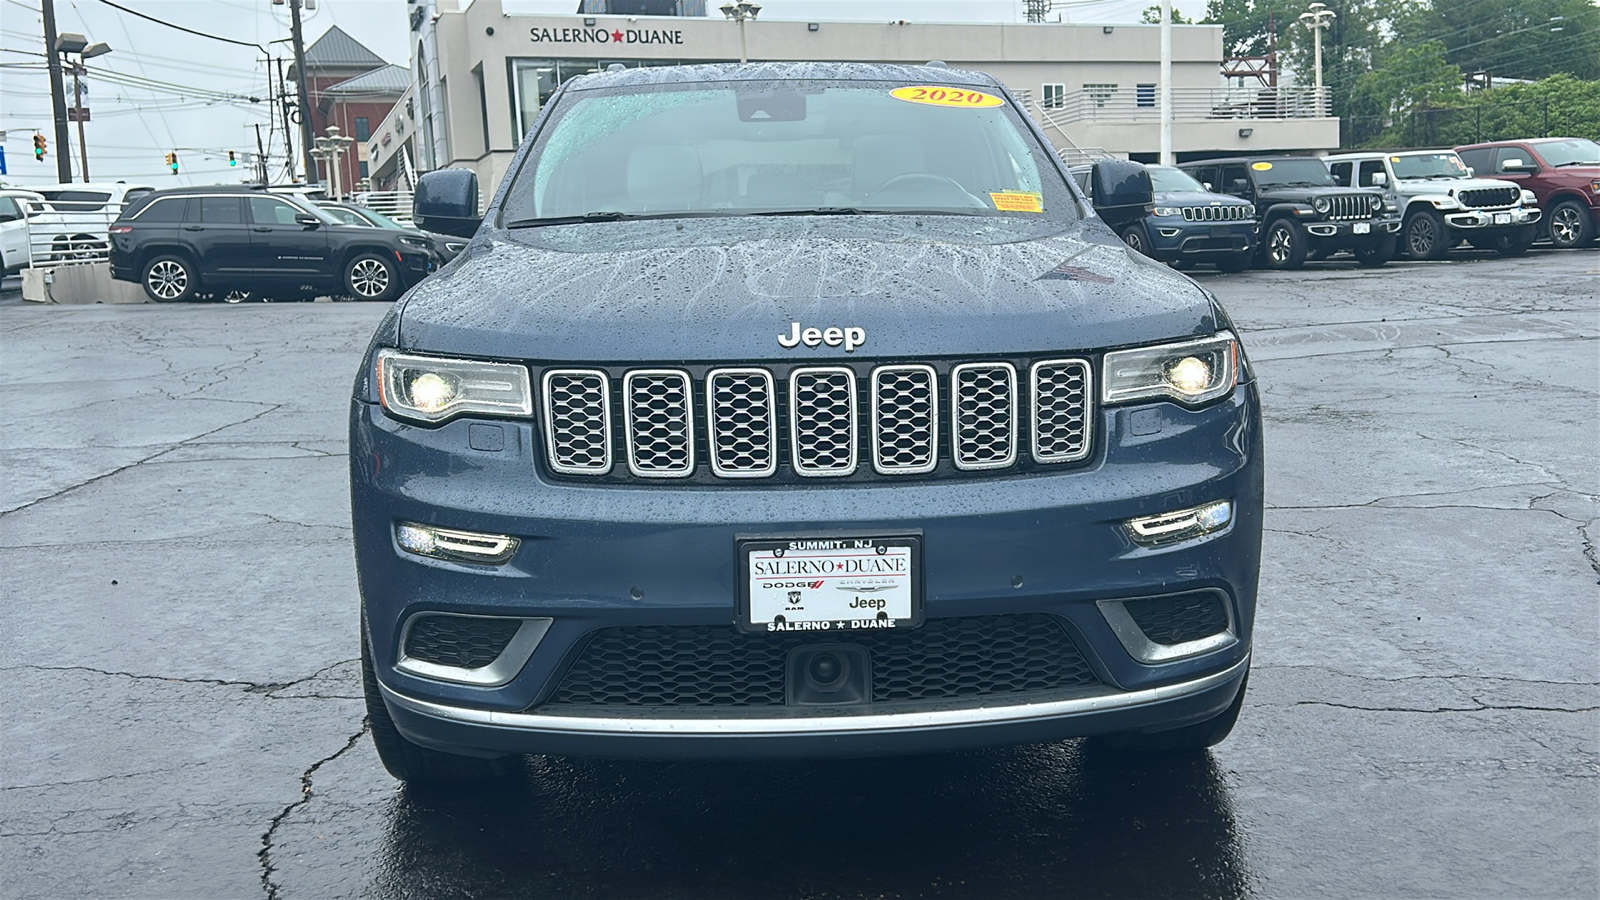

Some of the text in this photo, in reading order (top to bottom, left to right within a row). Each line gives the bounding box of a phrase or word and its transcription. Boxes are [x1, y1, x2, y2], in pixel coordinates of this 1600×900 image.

[530, 28, 684, 44] SALERNO DUANE
[910, 88, 984, 104] 2020
[777, 322, 866, 353] Jeep
[788, 539, 873, 550] SUMMIT, NJ
[754, 557, 906, 576] SALERNO DUANE
[762, 581, 817, 589] DODGE
[849, 596, 886, 610] Jeep
[767, 618, 896, 632] SALERNO DUANE
